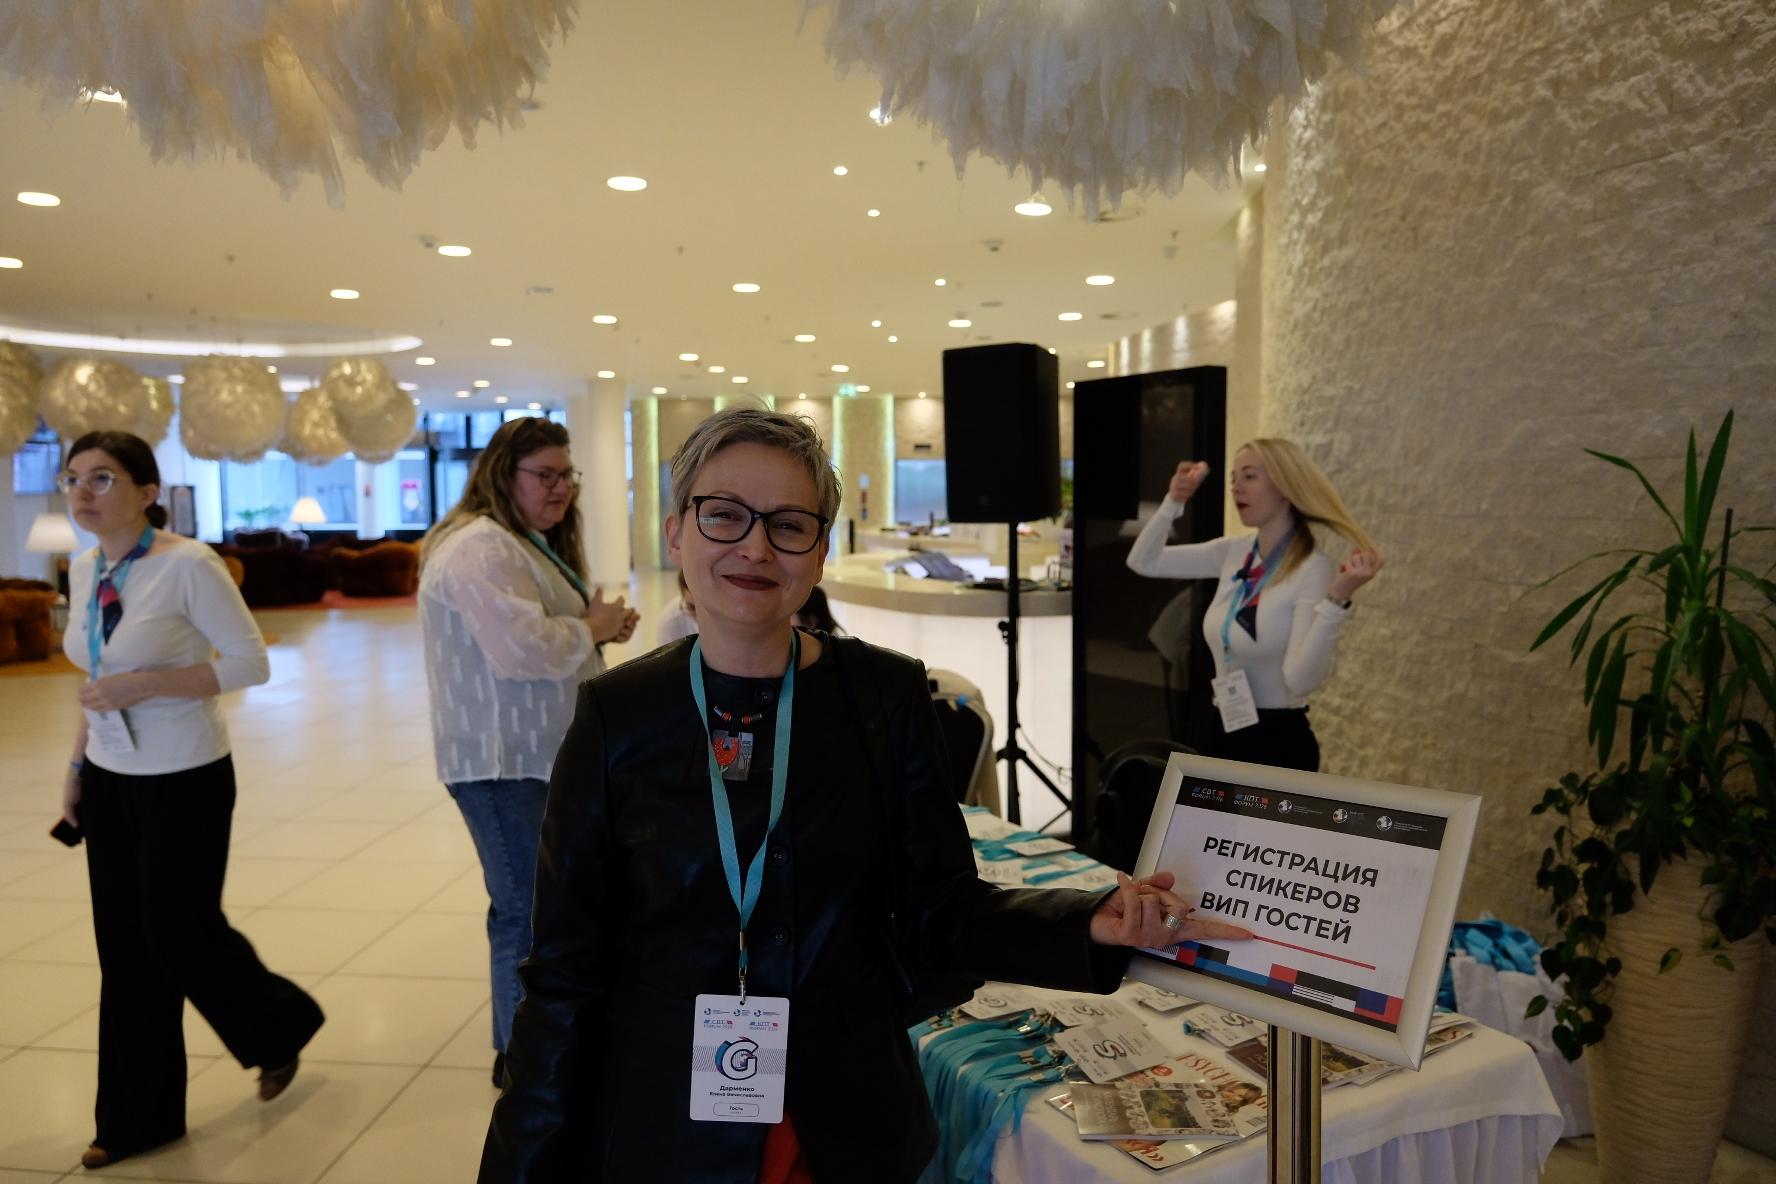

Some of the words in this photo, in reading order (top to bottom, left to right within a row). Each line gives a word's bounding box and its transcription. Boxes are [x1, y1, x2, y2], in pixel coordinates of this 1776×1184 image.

[1203, 836, 1379, 888] РЕГИСТРАЦИЯ
[1200, 891, 1250, 919] ВИП
[1254, 904, 1352, 944] ГОСТЕЙ
[1225, 869, 1361, 914] СПИКЕРОВ
